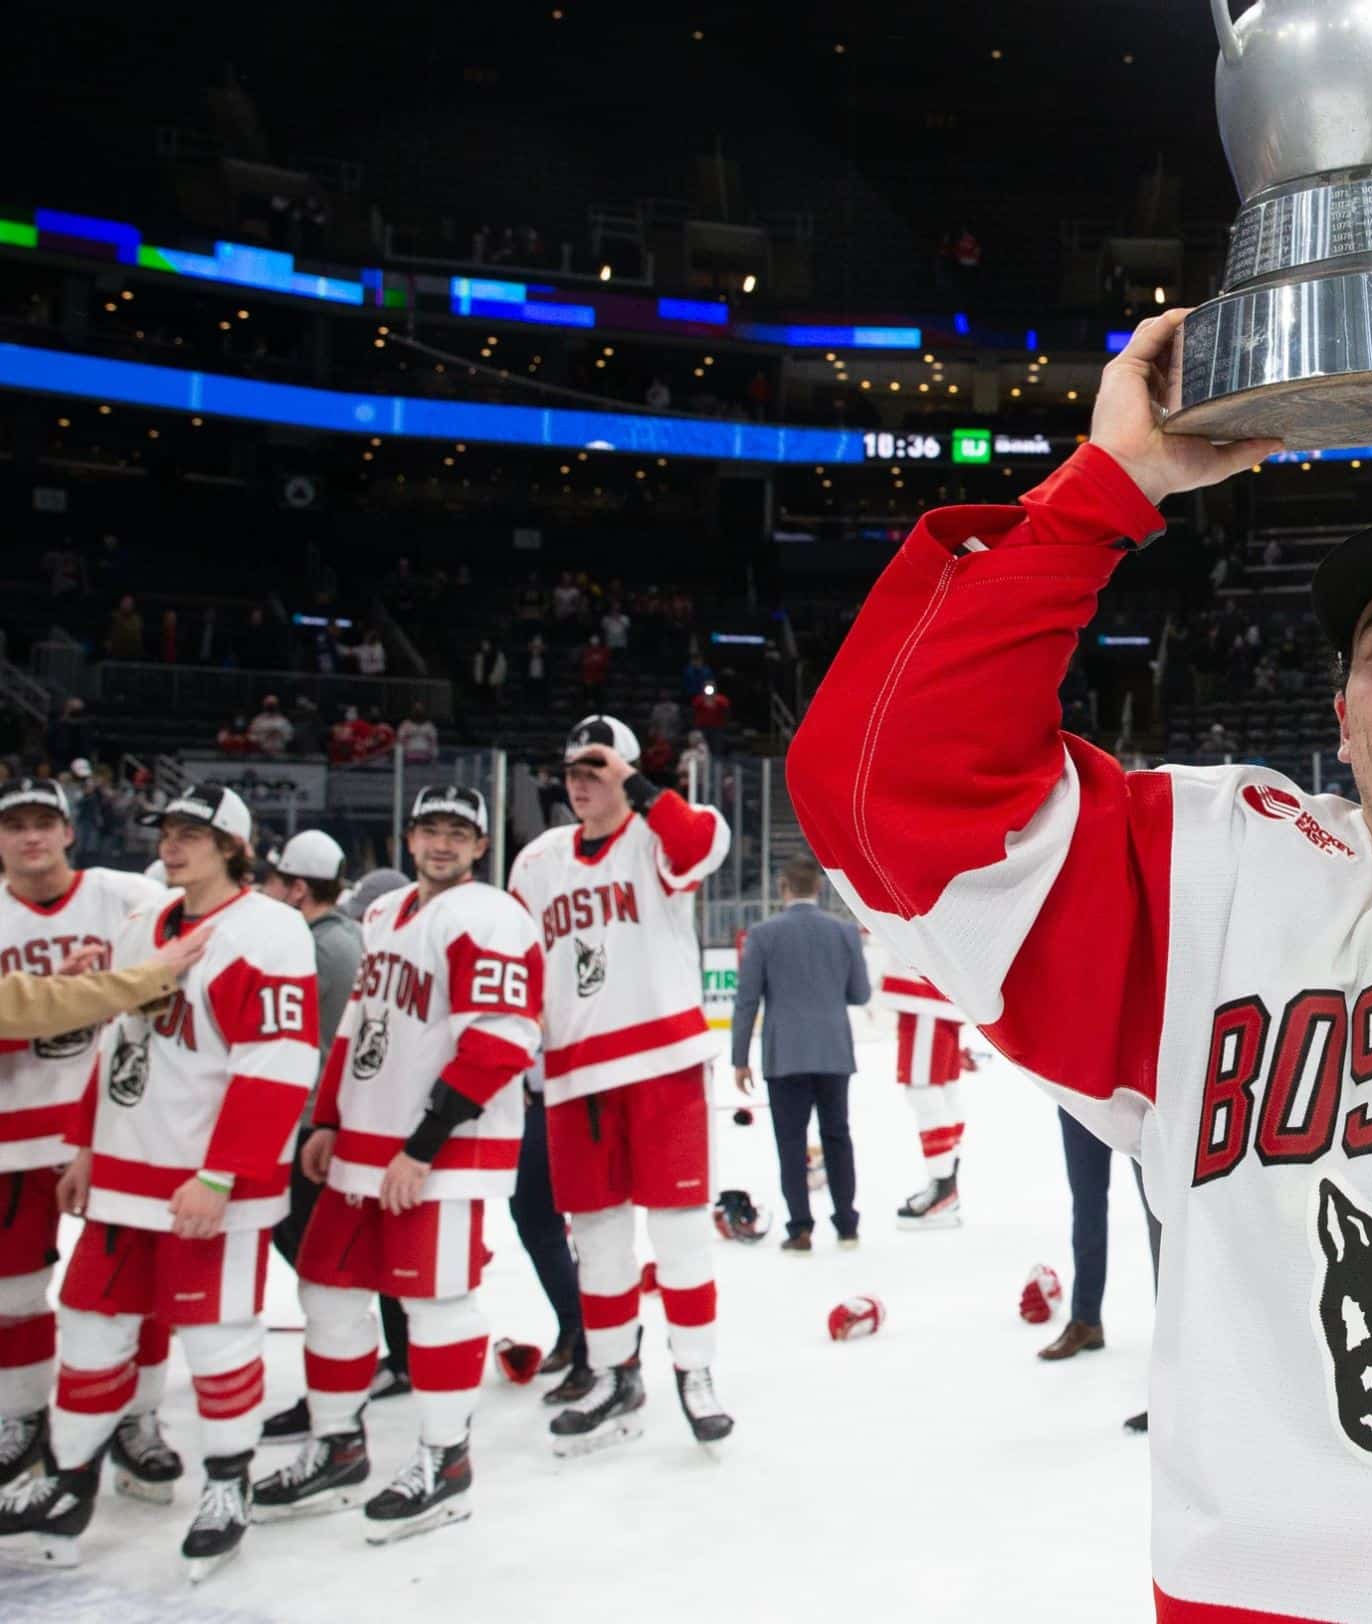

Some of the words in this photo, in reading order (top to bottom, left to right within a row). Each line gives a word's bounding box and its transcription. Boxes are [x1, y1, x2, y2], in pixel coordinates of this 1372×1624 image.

[1295, 819, 1331, 850] EAST
[1299, 811, 1356, 857] HOCKEY
[471, 958, 528, 1008] 26
[259, 985, 304, 1034] 16
